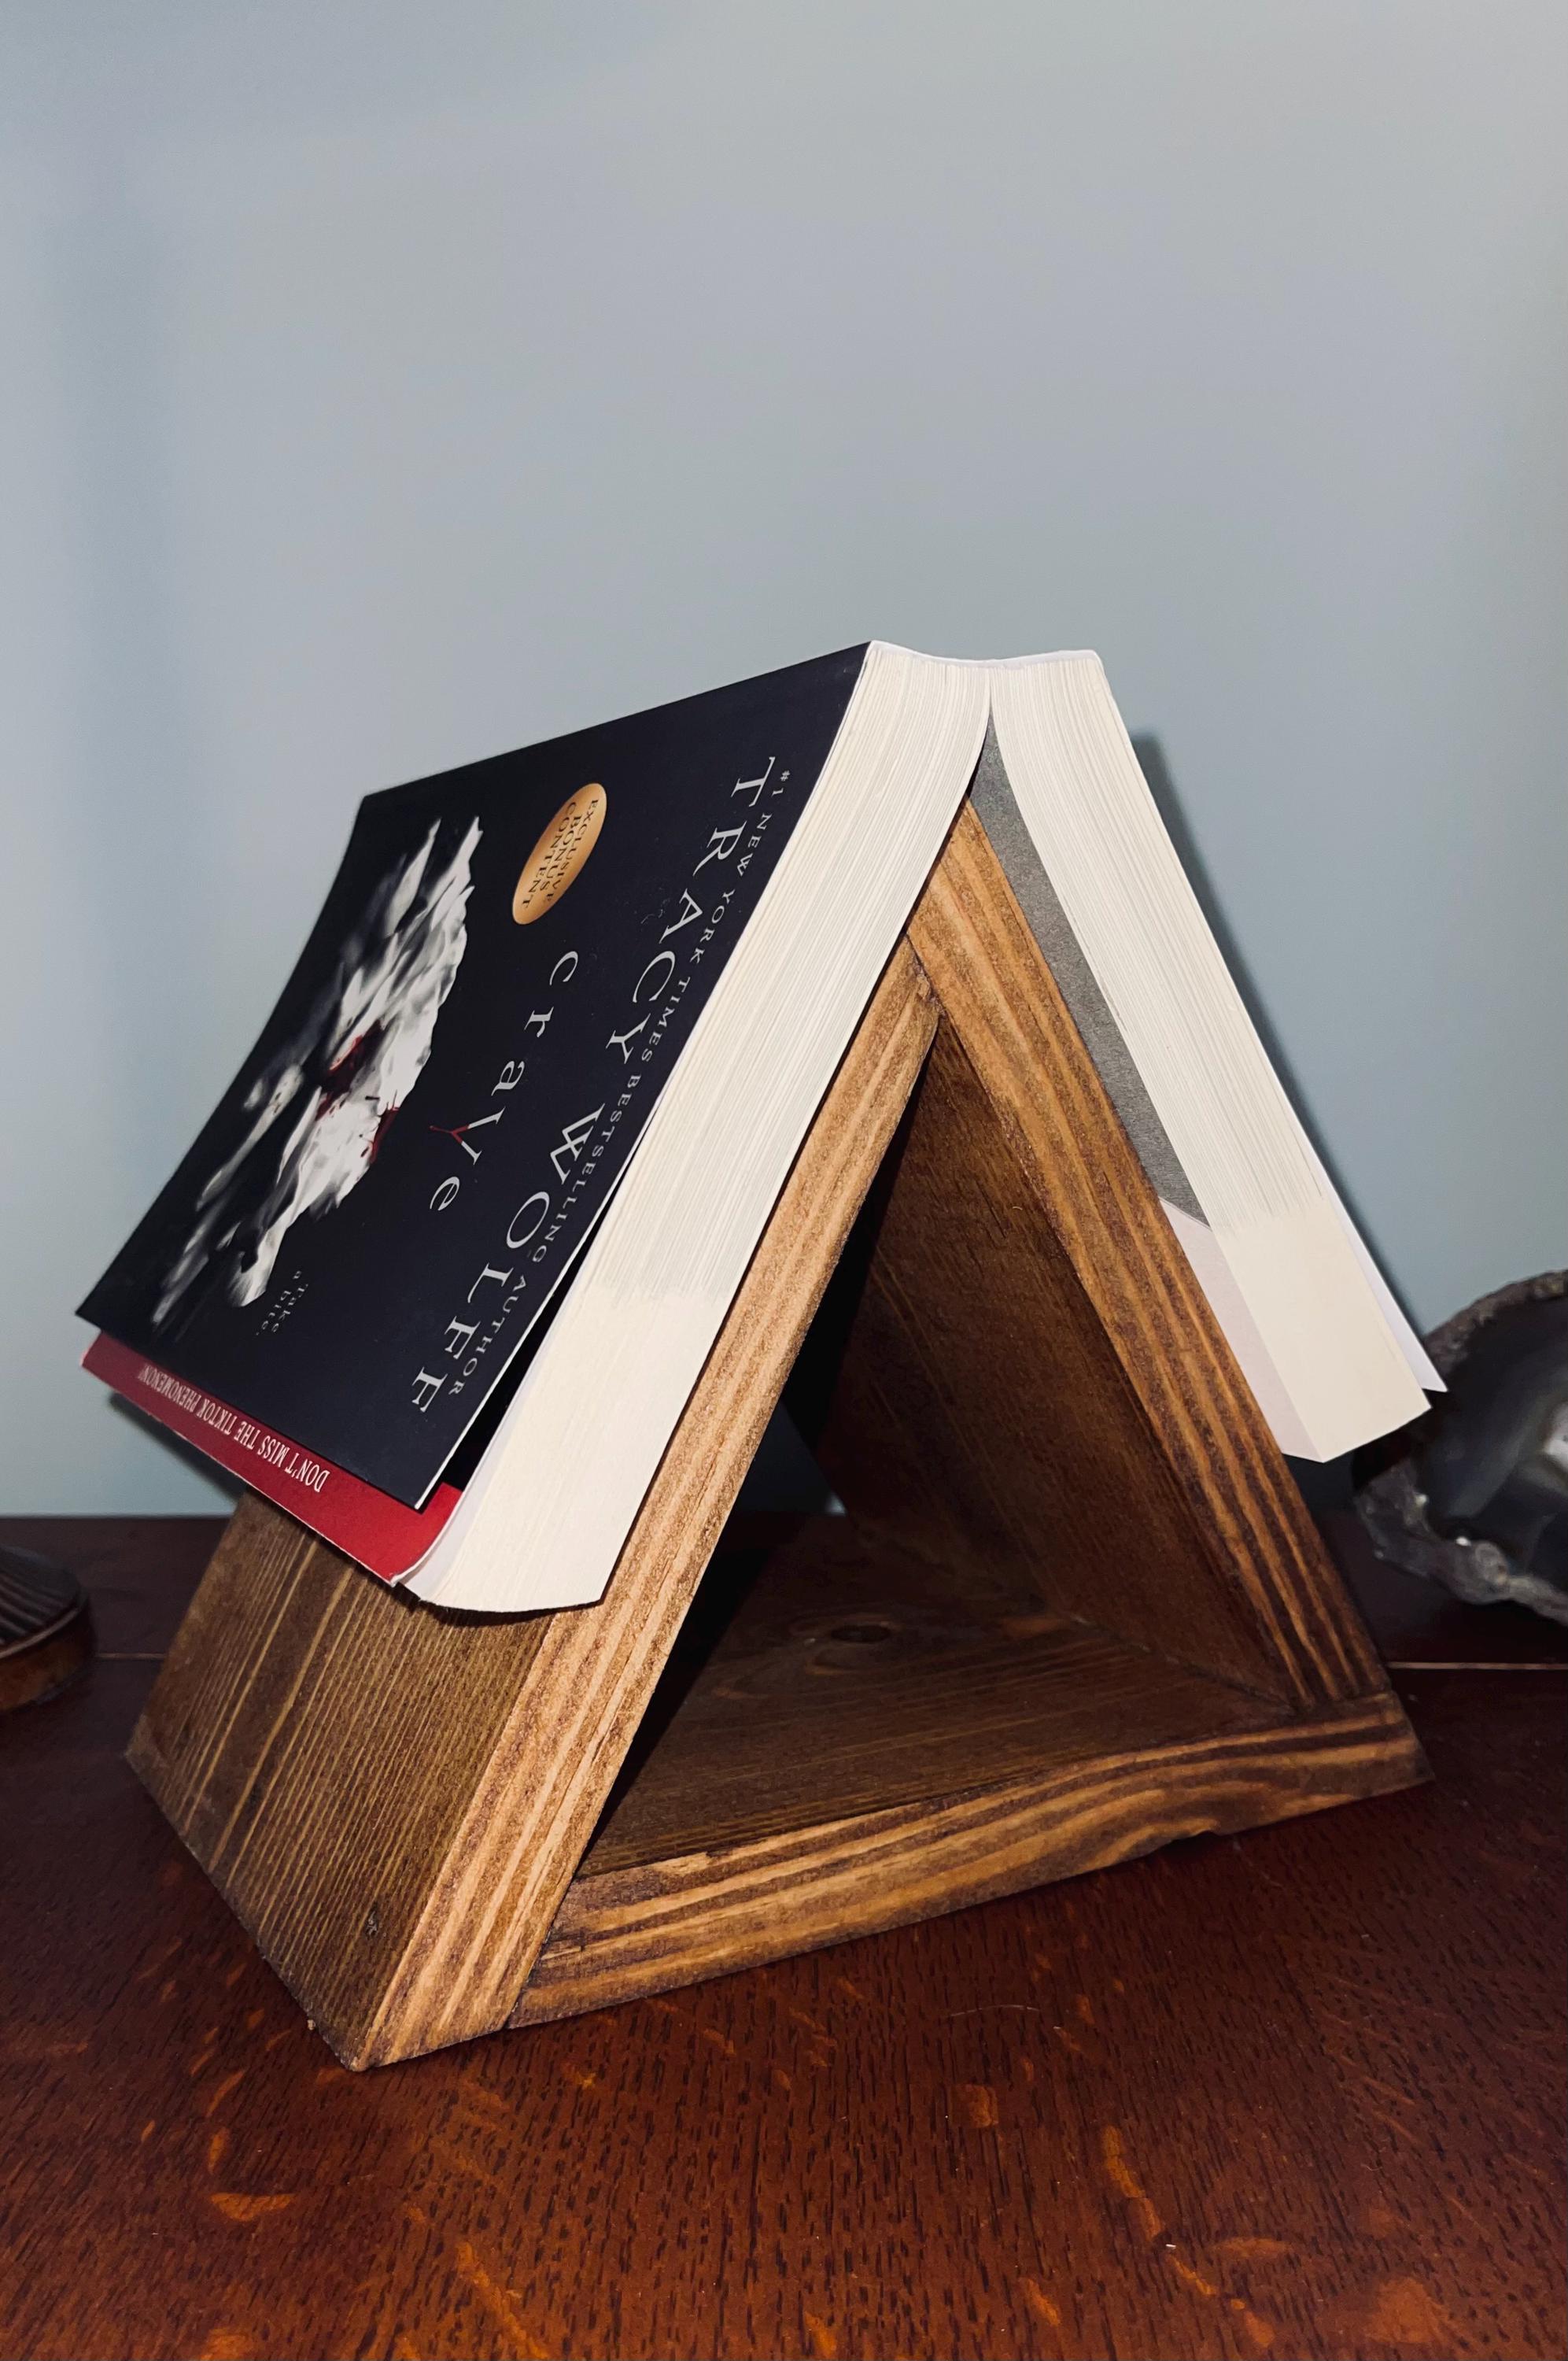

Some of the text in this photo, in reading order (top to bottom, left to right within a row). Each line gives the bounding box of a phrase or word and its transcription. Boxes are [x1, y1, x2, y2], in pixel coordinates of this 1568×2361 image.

[522, 801, 576, 910] CONTENT
[540, 815, 582, 891] BONUS
[544, 799, 599, 903] EXCLUSIVE
[411, 756, 776, 1413] TRACY WOLFF
[429, 951, 578, 1211] crave
[448, 770, 791, 1395] #1 NEW YORK TIMES BESTSELLING AUTHOR
[196, 1398, 238, 1436] TIKTOK
[234, 1420, 261, 1450] THE
[256, 1435, 290, 1468] MISS
[284, 1452, 330, 1493] DON'T
